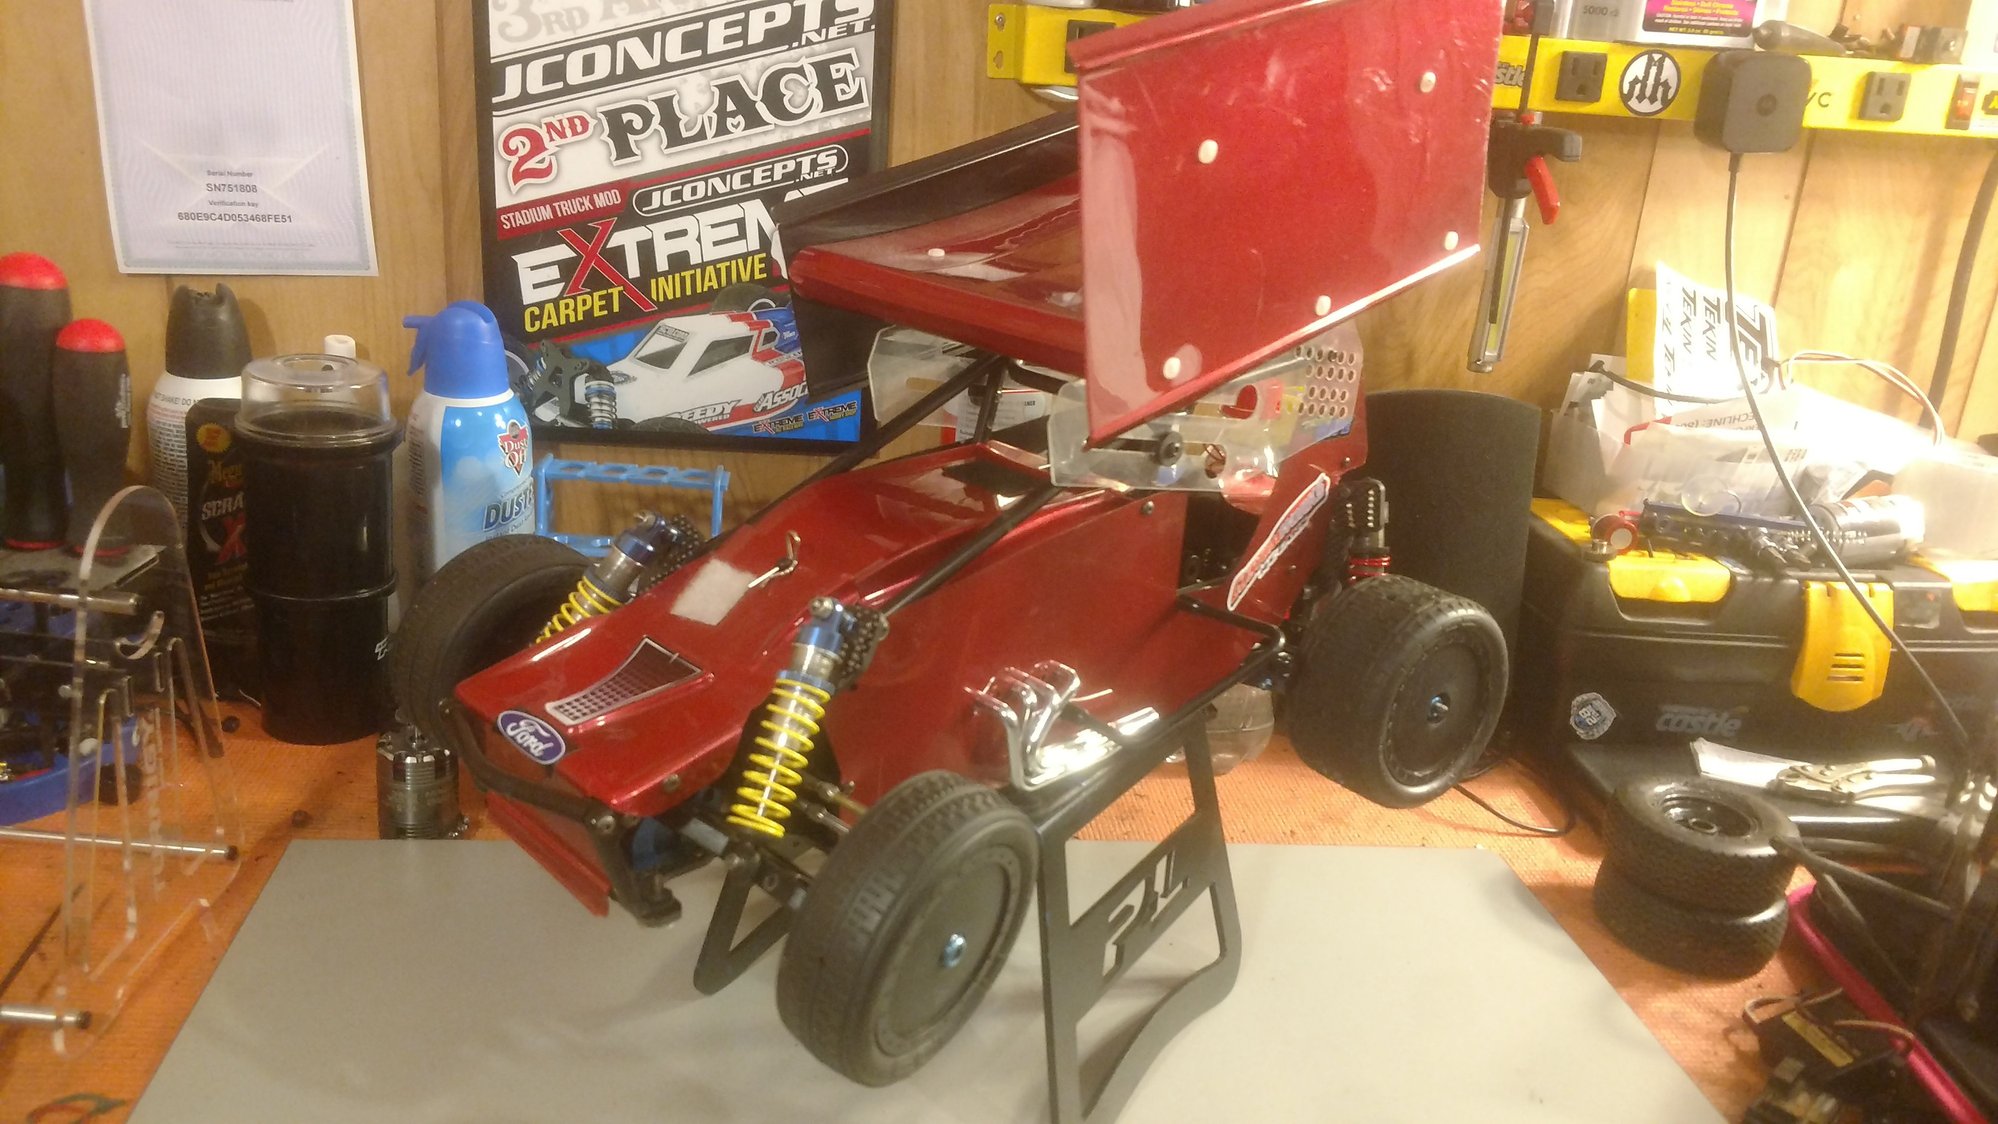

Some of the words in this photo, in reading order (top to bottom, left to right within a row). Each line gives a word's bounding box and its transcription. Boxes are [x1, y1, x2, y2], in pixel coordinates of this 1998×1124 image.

[492, 0, 874, 104] JCONCEPTS
[499, 114, 592, 188] 2ND
[598, 53, 868, 163] PLACE
[206, 183, 258, 193] SN751808
[500, 204, 552, 231] STADIUM
[553, 194, 594, 218] TRUCK
[594, 188, 622, 210] MOD
[642, 149, 839, 212] JCONCEPTS
[523, 285, 625, 333] CARPET
[649, 252, 768, 303] INITIATIVE
[1680, 286, 1697, 355] TEKIN
[1702, 295, 1721, 361] TEKIN
[504, 438, 529, 453] Dust
[505, 717, 554, 758] Ford
